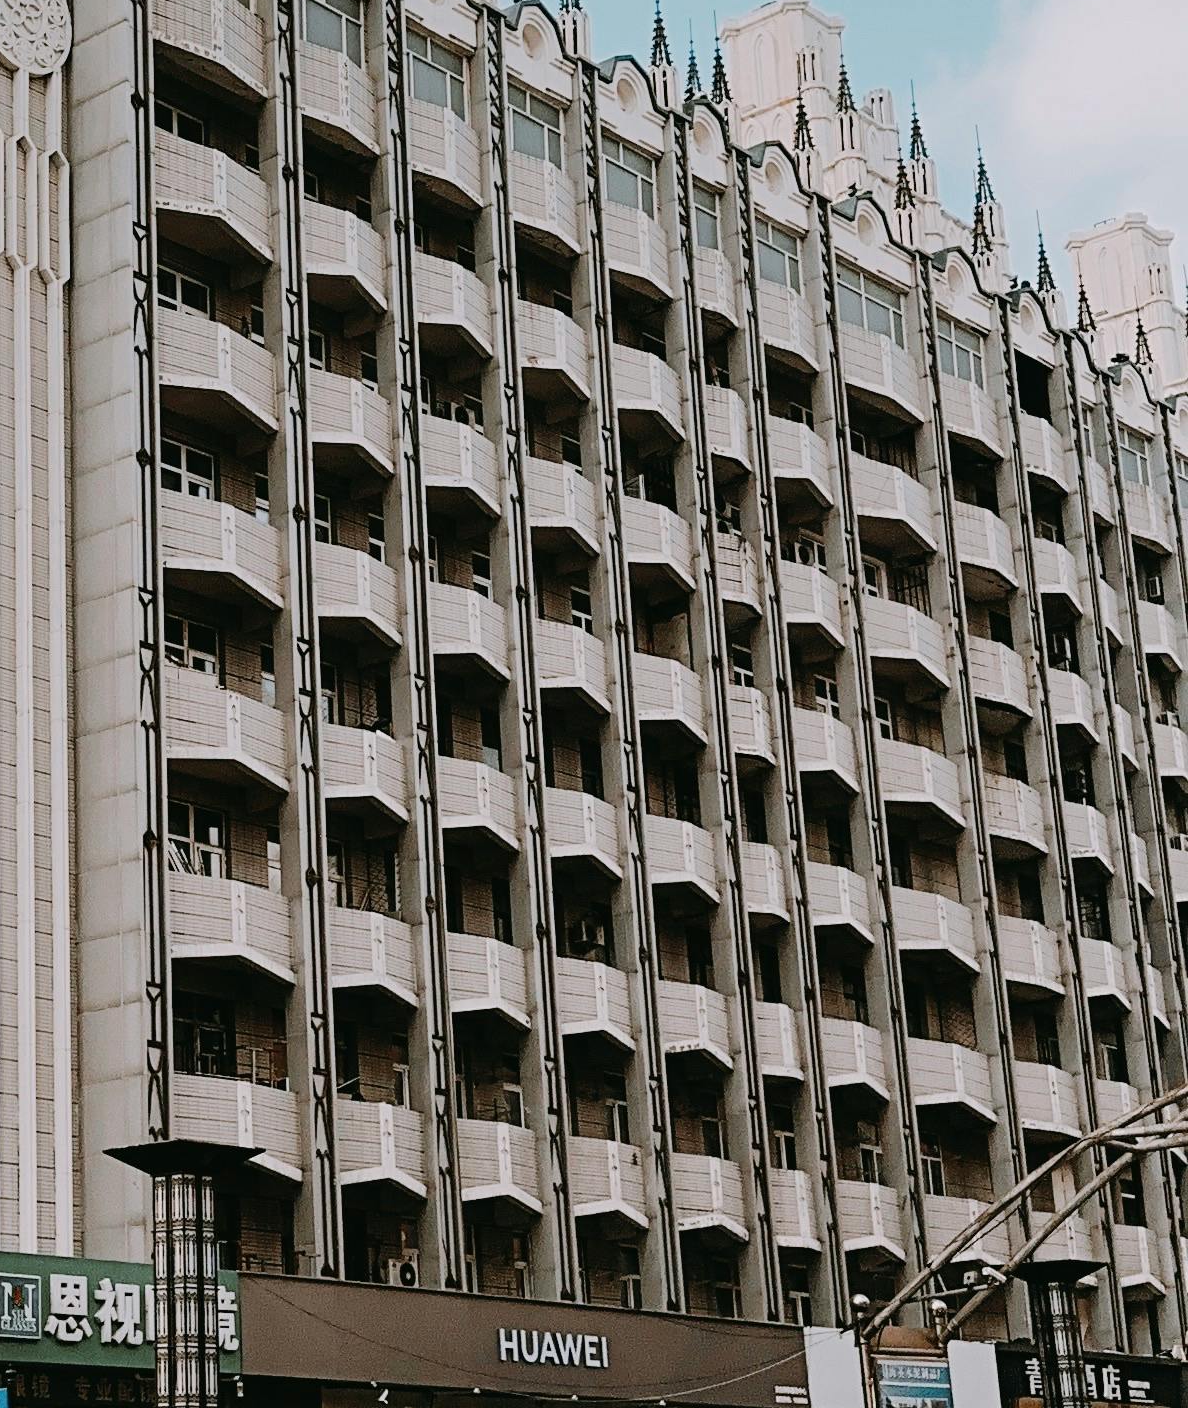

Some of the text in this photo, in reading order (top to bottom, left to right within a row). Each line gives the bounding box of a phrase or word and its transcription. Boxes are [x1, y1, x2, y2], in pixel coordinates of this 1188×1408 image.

[1, 1321, 36, 1333] GLASSES
[44, 1273, 240, 1351] 恩视
[499, 1328, 609, 1368] HUAWEI
